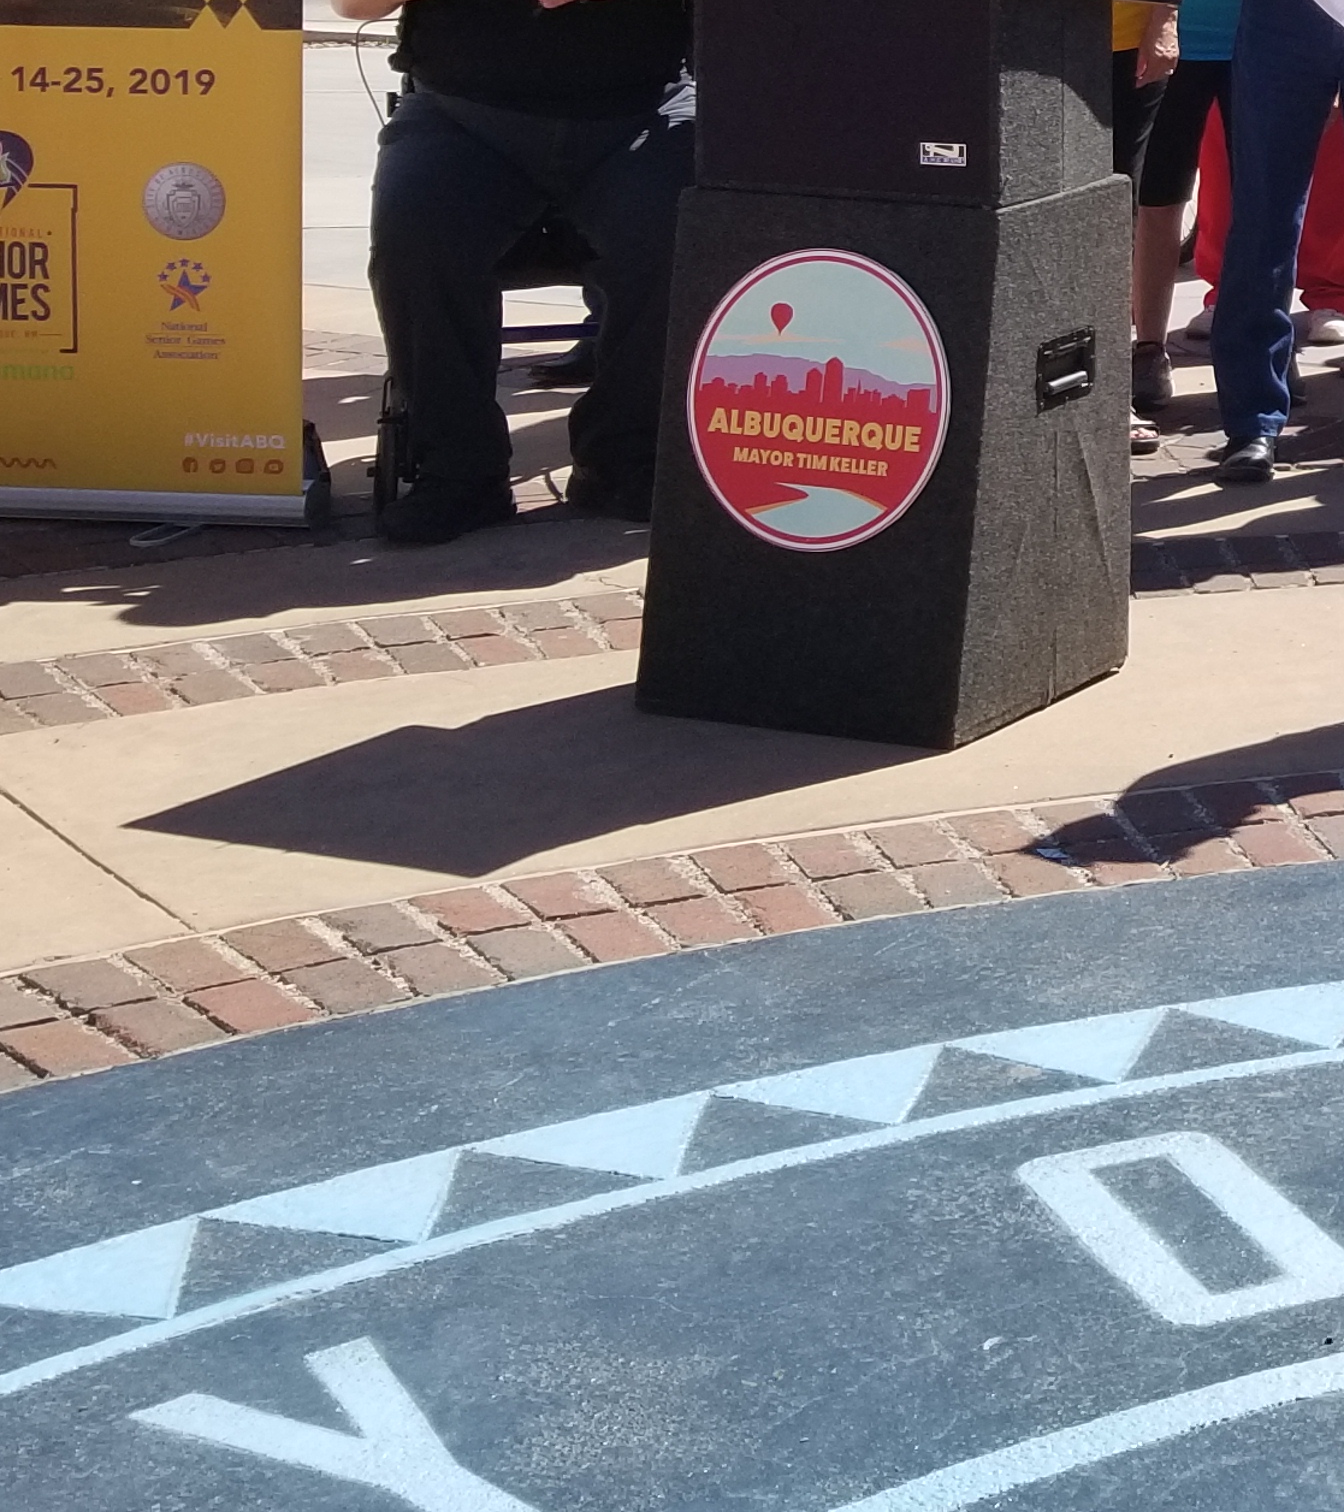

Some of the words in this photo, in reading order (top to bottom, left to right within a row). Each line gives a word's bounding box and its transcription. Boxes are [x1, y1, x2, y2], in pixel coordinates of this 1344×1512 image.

[11, 66, 114, 98] 14-25,
[128, 68, 216, 95] 2019
[184, 433, 286, 449] #VisitABQ
[707, 407, 922, 452] ALBUQUERQUE
[733, 446, 793, 467] MAYOR
[796, 452, 827, 470] TIM
[829, 457, 889, 477] KELLER
